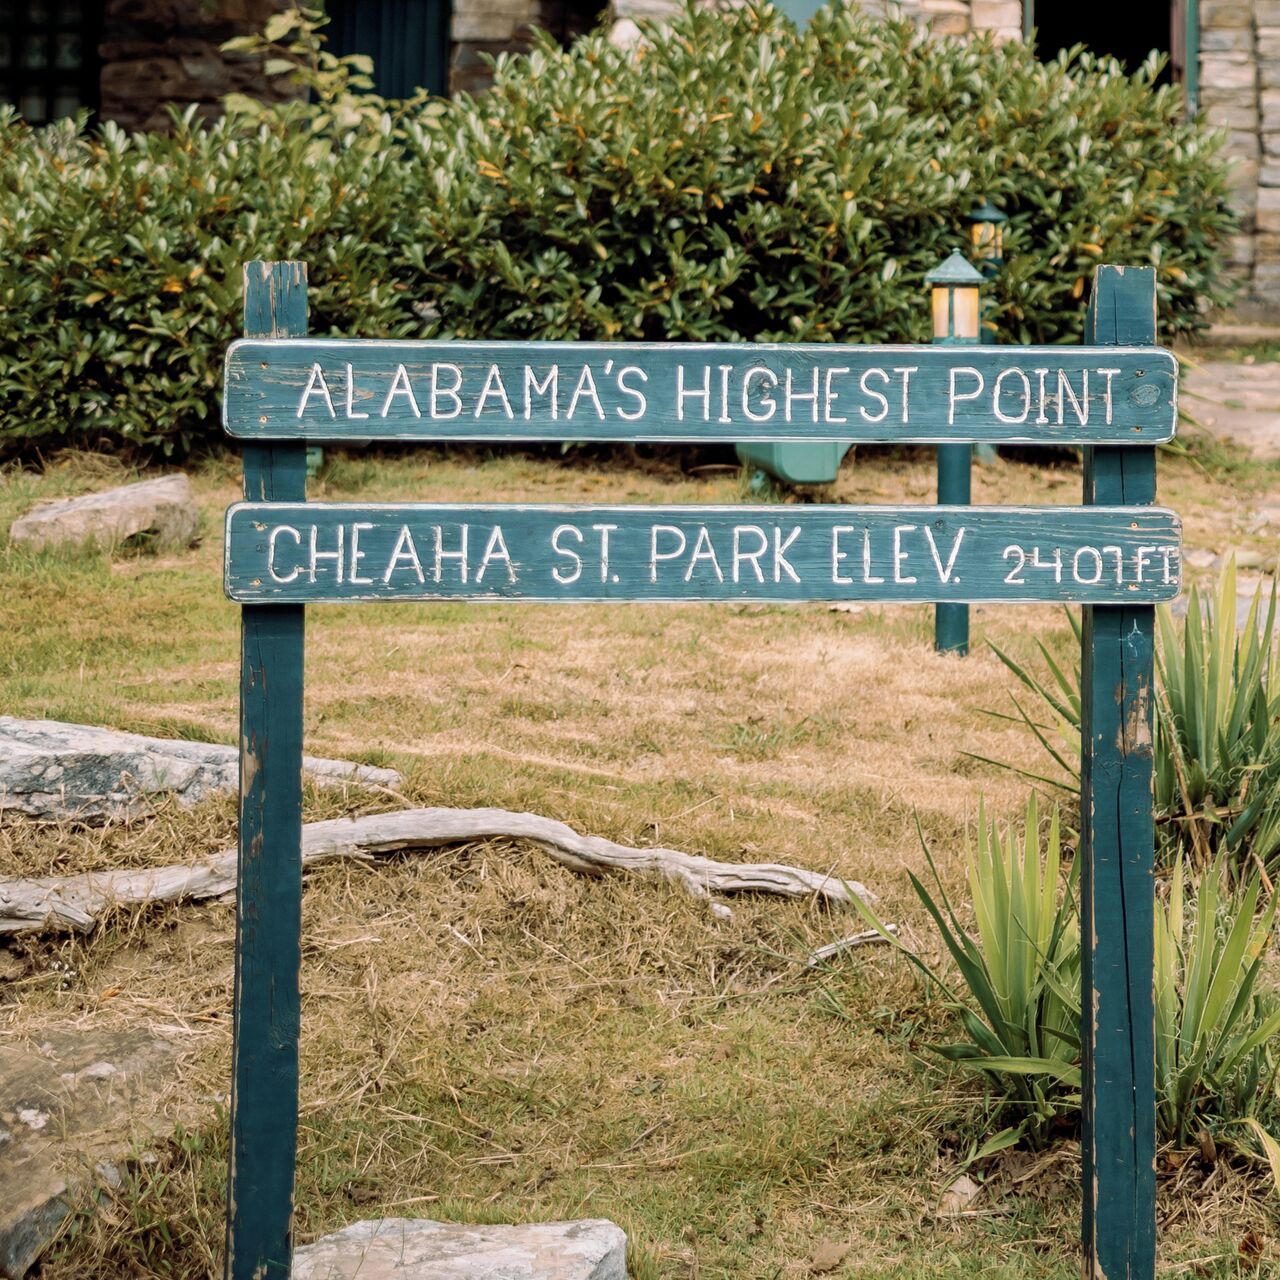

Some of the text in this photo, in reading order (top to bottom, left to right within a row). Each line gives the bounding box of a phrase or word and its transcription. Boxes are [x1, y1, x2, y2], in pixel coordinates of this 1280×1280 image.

[296, 359, 1121, 425] ALABAMA'S HIGHEST POINT
[267, 523, 517, 584] CHEAHA
[551, 524, 620, 585] ST.
[651, 525, 801, 584] PARK
[831, 525, 966, 585] ELEV.
